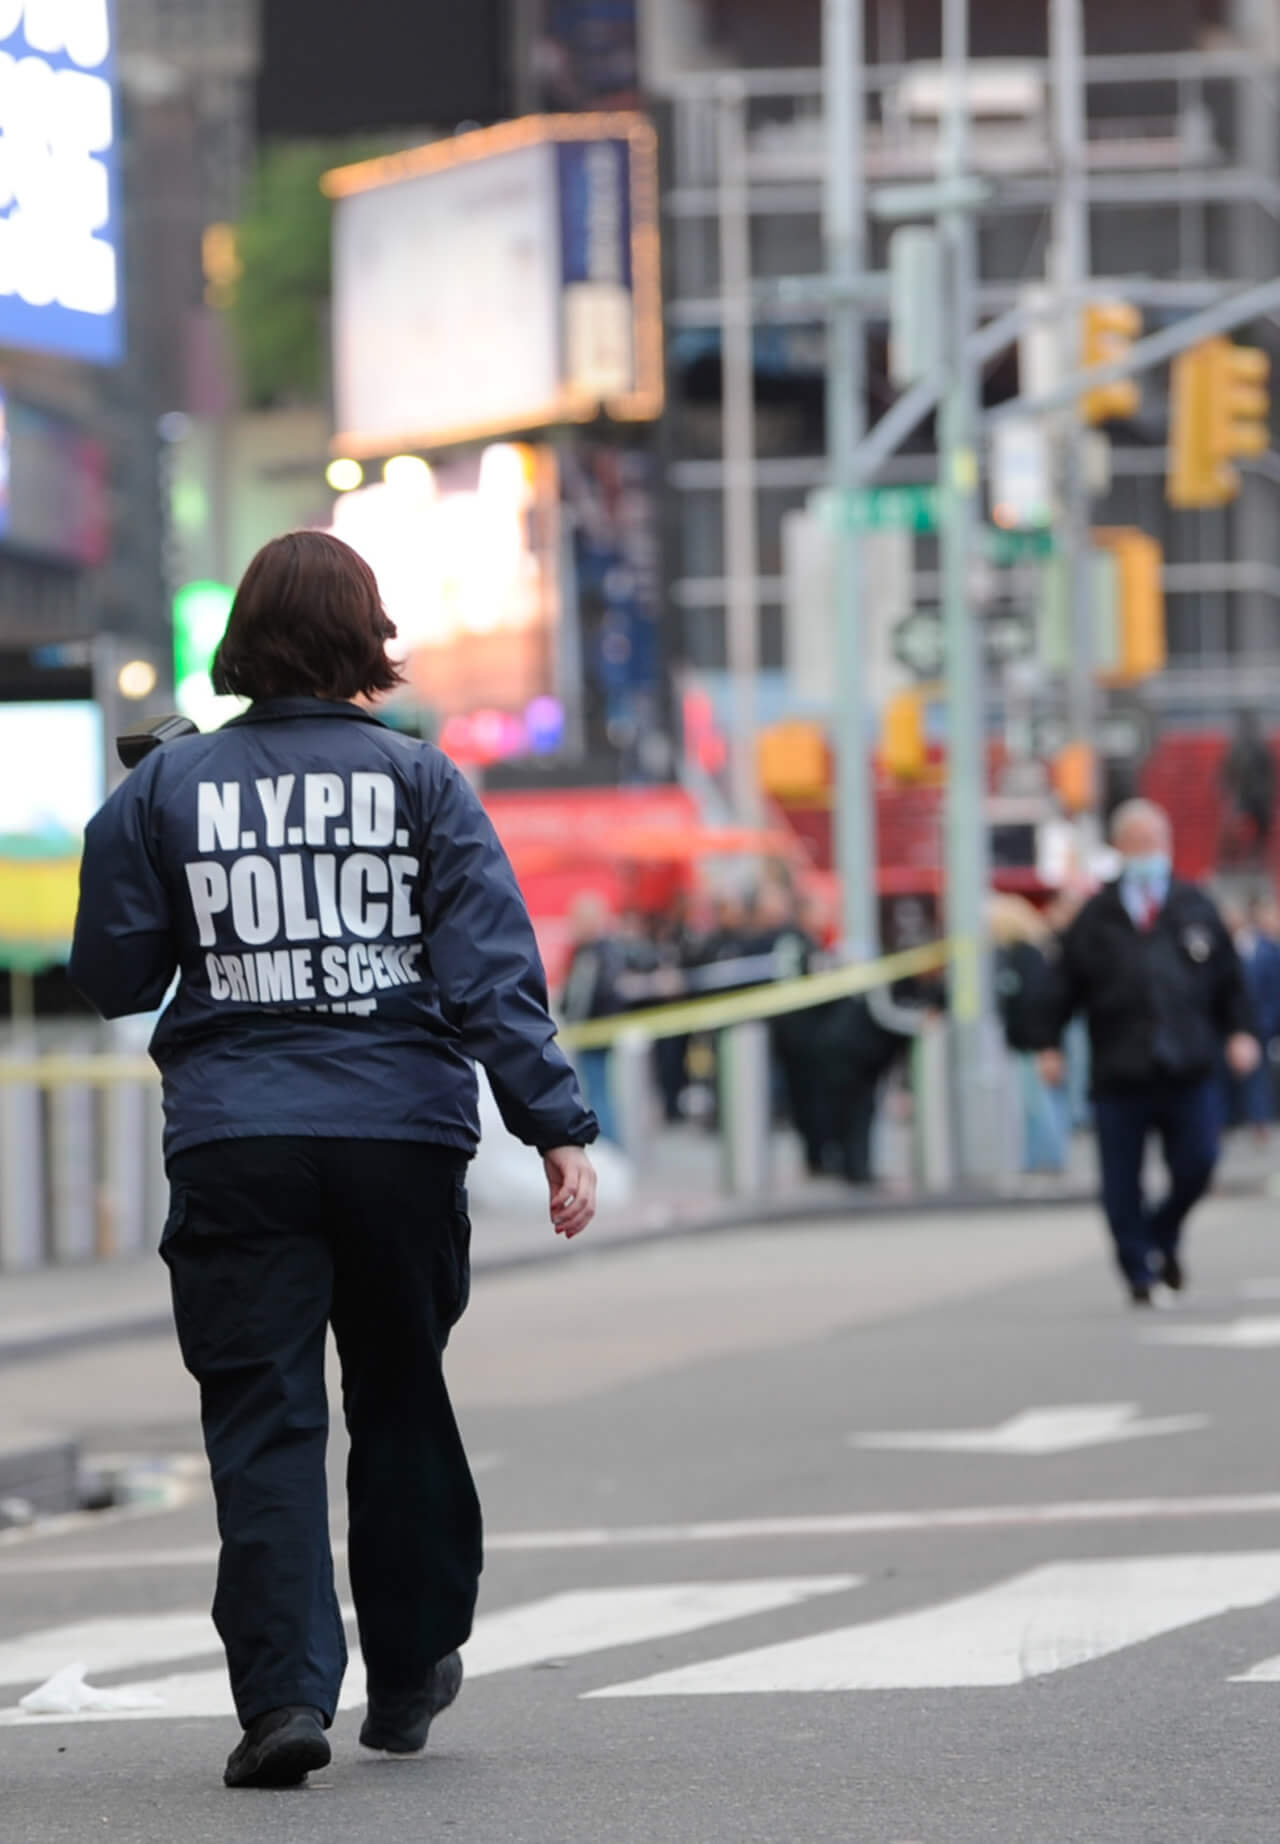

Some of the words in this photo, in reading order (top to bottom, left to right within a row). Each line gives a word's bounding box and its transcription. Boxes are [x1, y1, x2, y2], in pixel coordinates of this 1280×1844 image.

[197, 771, 410, 853] N.Y.P.D.
[184, 852, 422, 947] POLICE
[205, 949, 317, 1003] CRIME
[321, 943, 423, 997] SCENE
